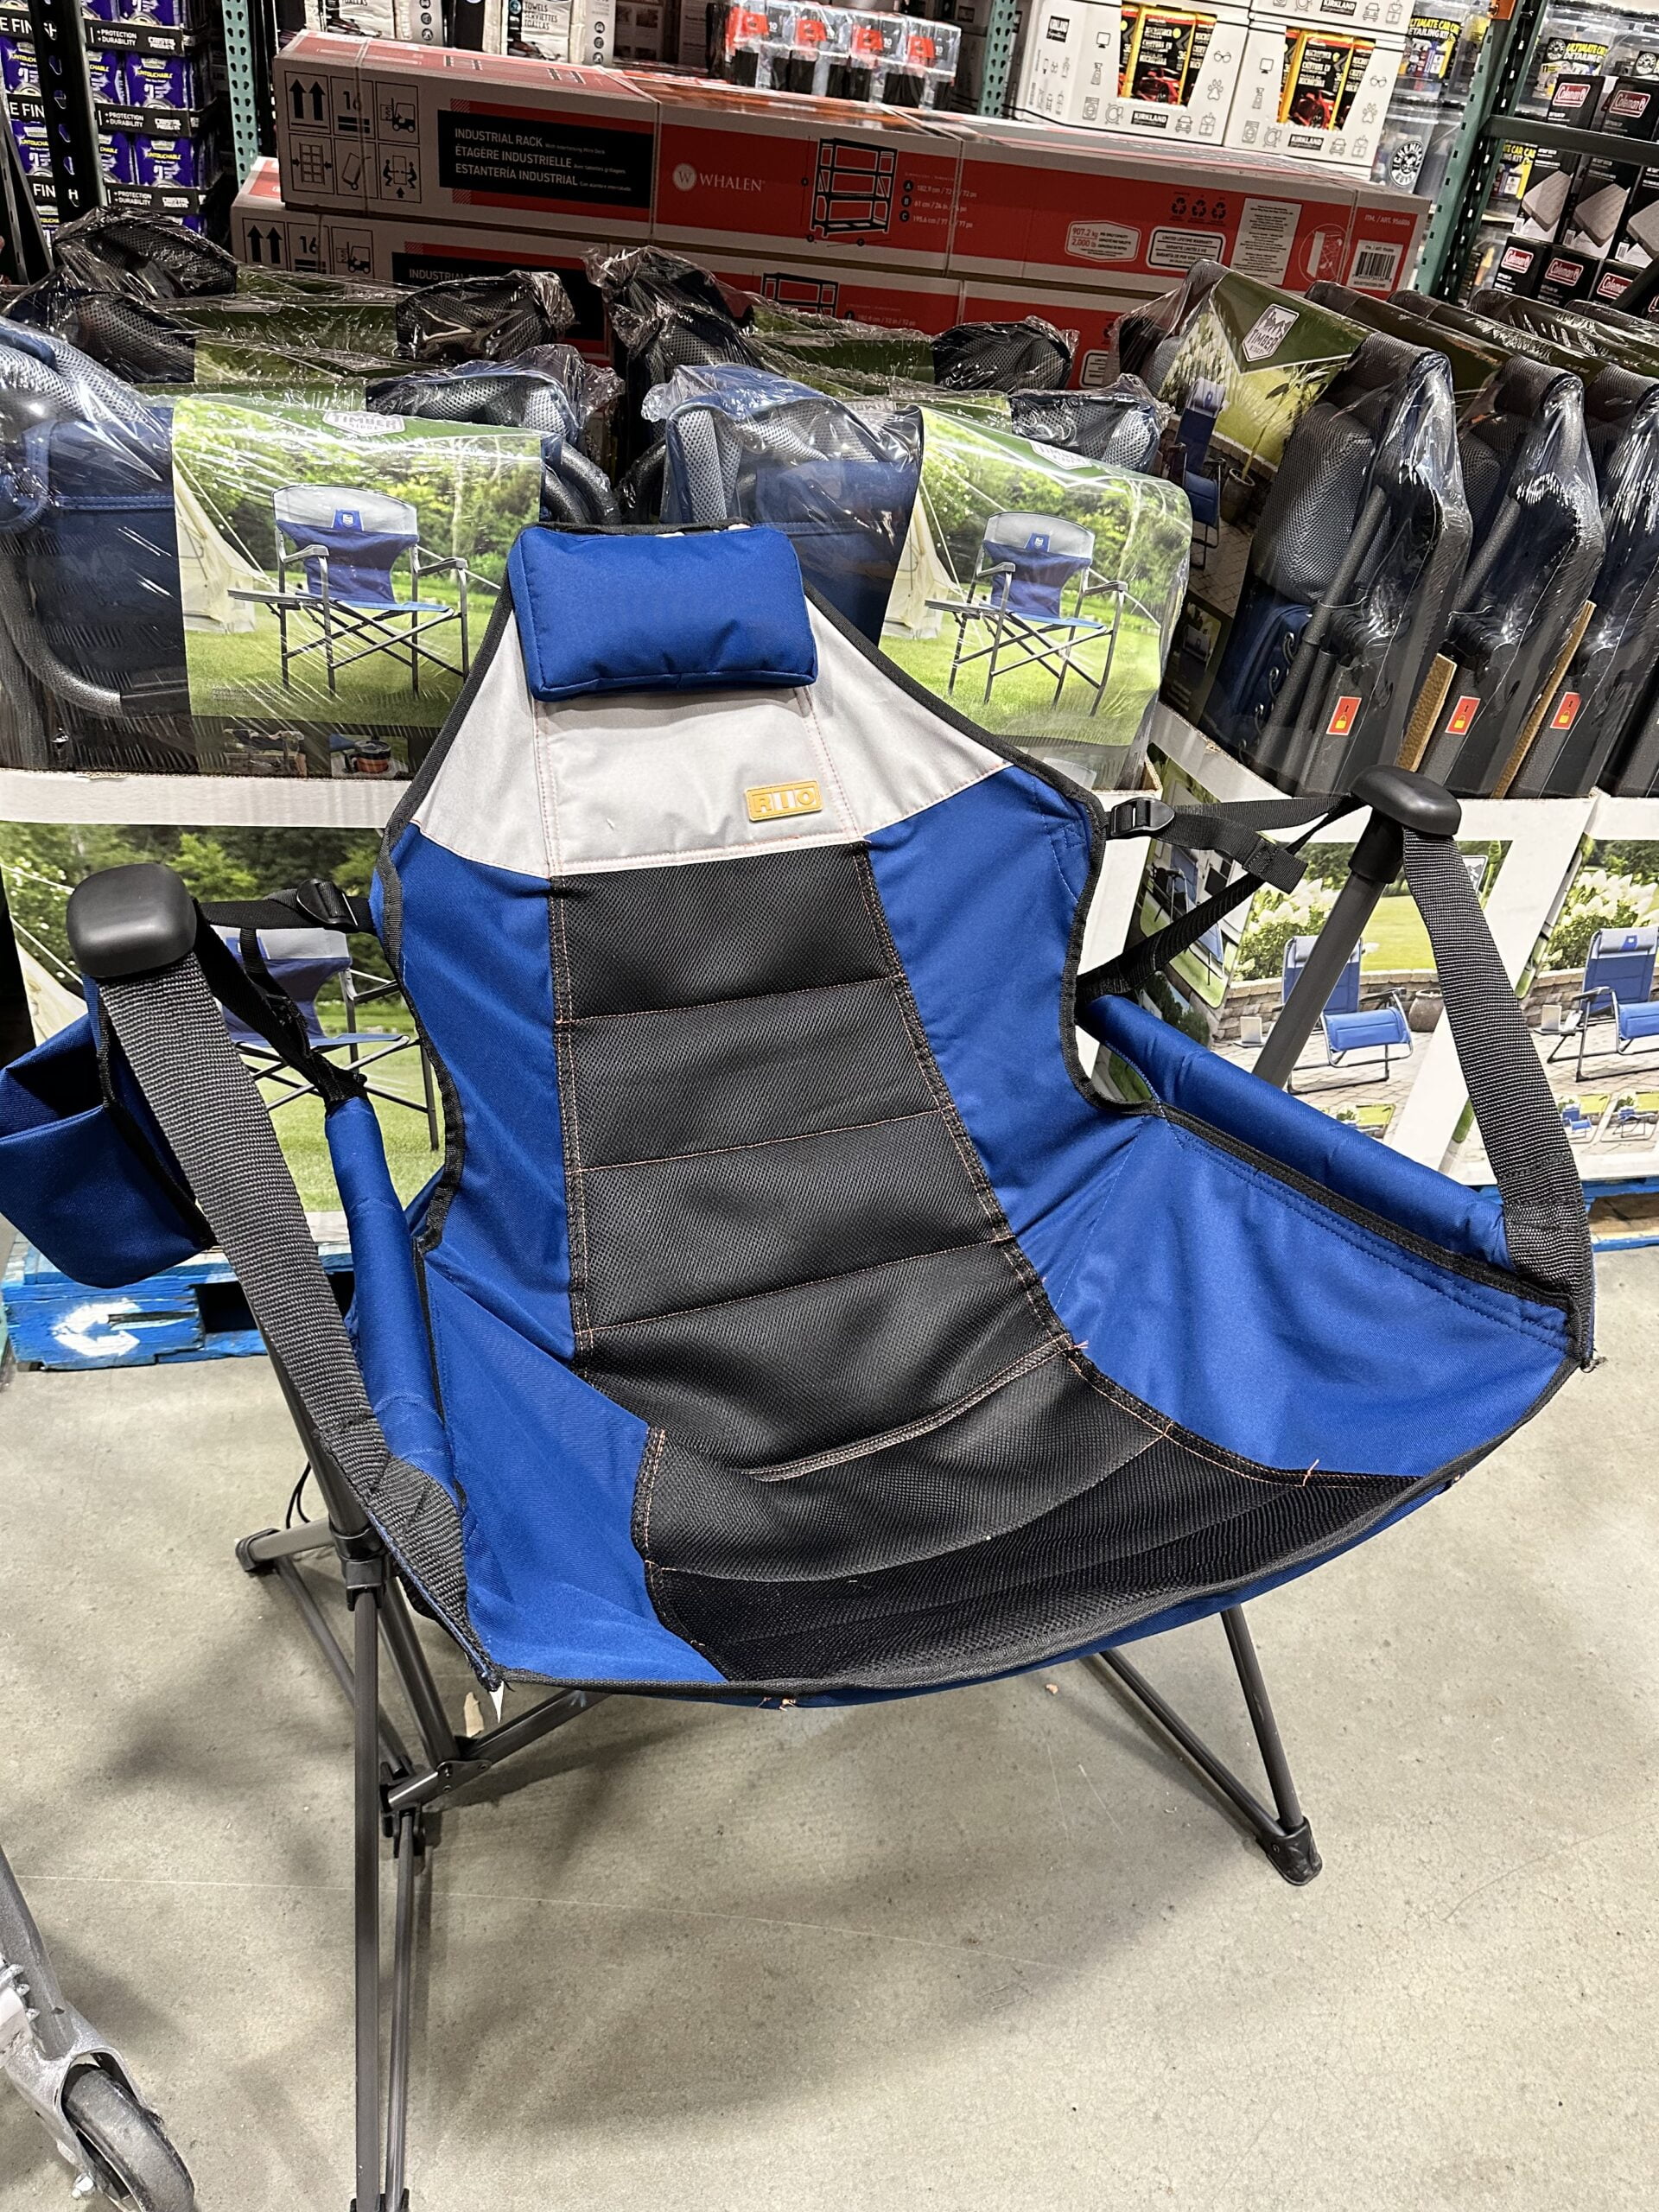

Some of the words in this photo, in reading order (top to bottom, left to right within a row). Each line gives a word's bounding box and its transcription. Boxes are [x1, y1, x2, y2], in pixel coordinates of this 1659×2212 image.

[524, 2, 548, 12] TOWELS
[1323, 0, 1355, 10] KIRKLAND
[524, 10, 557, 22] SERVIETTES
[101, 29, 137, 40] PROTECTION
[102, 36, 137, 47] DURABILITY
[1566, 42, 1598, 54] ULTIMATE
[343, 91, 361, 111] 16
[109, 111, 144, 121] PROTECTION
[1134, 112, 1166, 124] KIRKLAND
[110, 119, 143, 128] DURABILITY
[454, 128, 513, 145] INDUSTRIAL
[516, 135, 543, 148] RACK
[1291, 136, 1322, 146] KIRKLAND
[1511, 145, 1523, 155] CAR
[502, 150, 572, 168] INDUSTRIELLE
[455, 162, 517, 179] ESTANTERÍA
[519, 171, 578, 187] INDUSTRIAL
[699, 172, 762, 193] WHALEN
[118, 191, 152, 200] PROTECTION
[118, 198, 151, 207] DURABILITY
[1072, 227, 1090, 237] 907.2
[300, 235, 318, 255] 16
[1248, 329, 1279, 353] TIMBER
[333, 414, 397, 429] TIMBER
[754, 791, 814, 812] RIO
